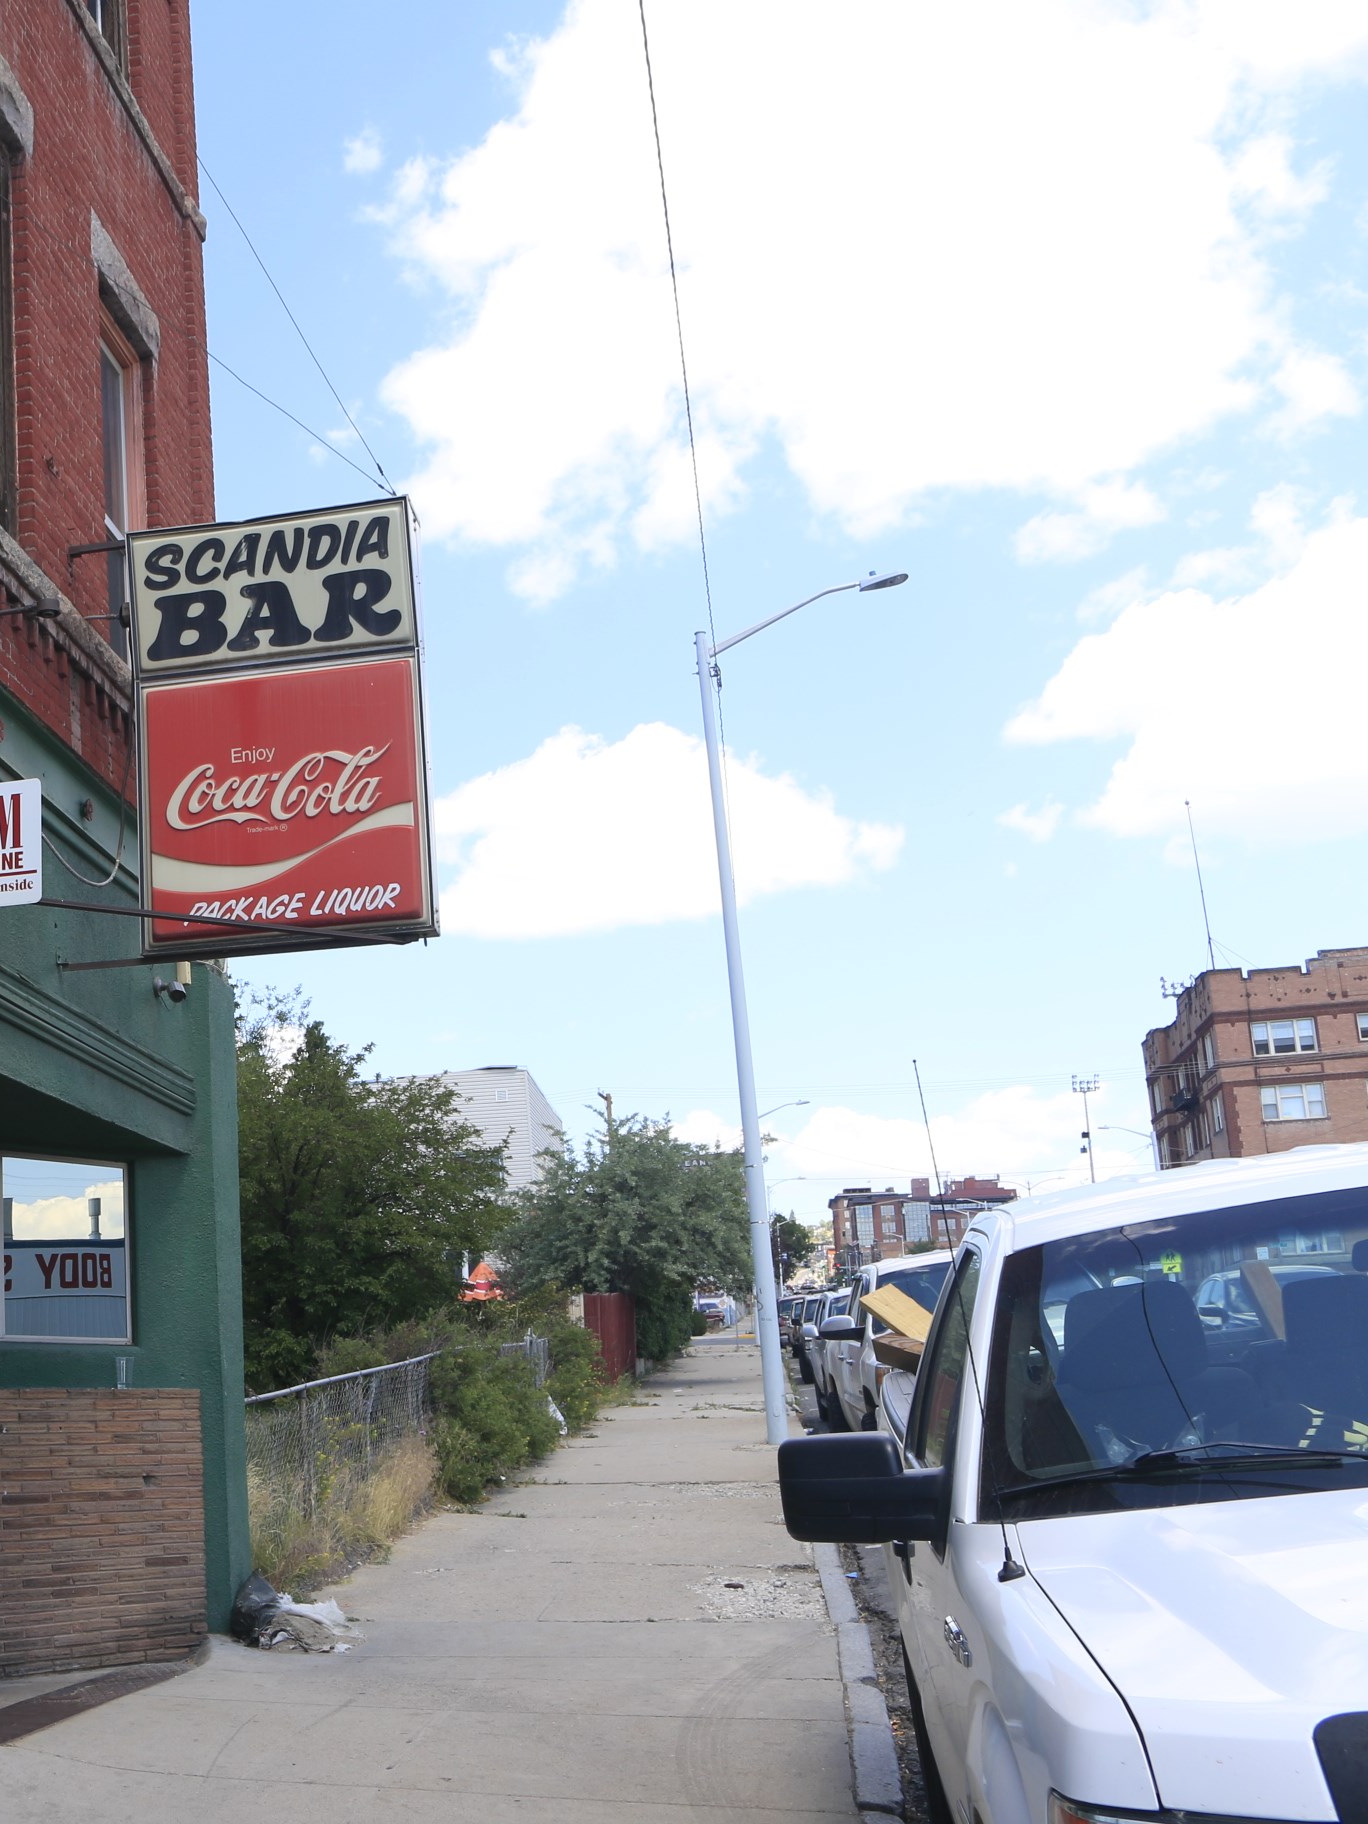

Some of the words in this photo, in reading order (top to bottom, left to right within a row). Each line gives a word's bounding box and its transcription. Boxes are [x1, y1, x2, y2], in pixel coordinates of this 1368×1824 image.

[144, 516, 390, 590] SCANDIA
[147, 569, 402, 661] BAR
[166, 740, 392, 830] Coca-Cola
[231, 745, 275, 764] Enjoy
[183, 893, 306, 926] PACKAGE
[310, 883, 401, 916] LIQUOR
